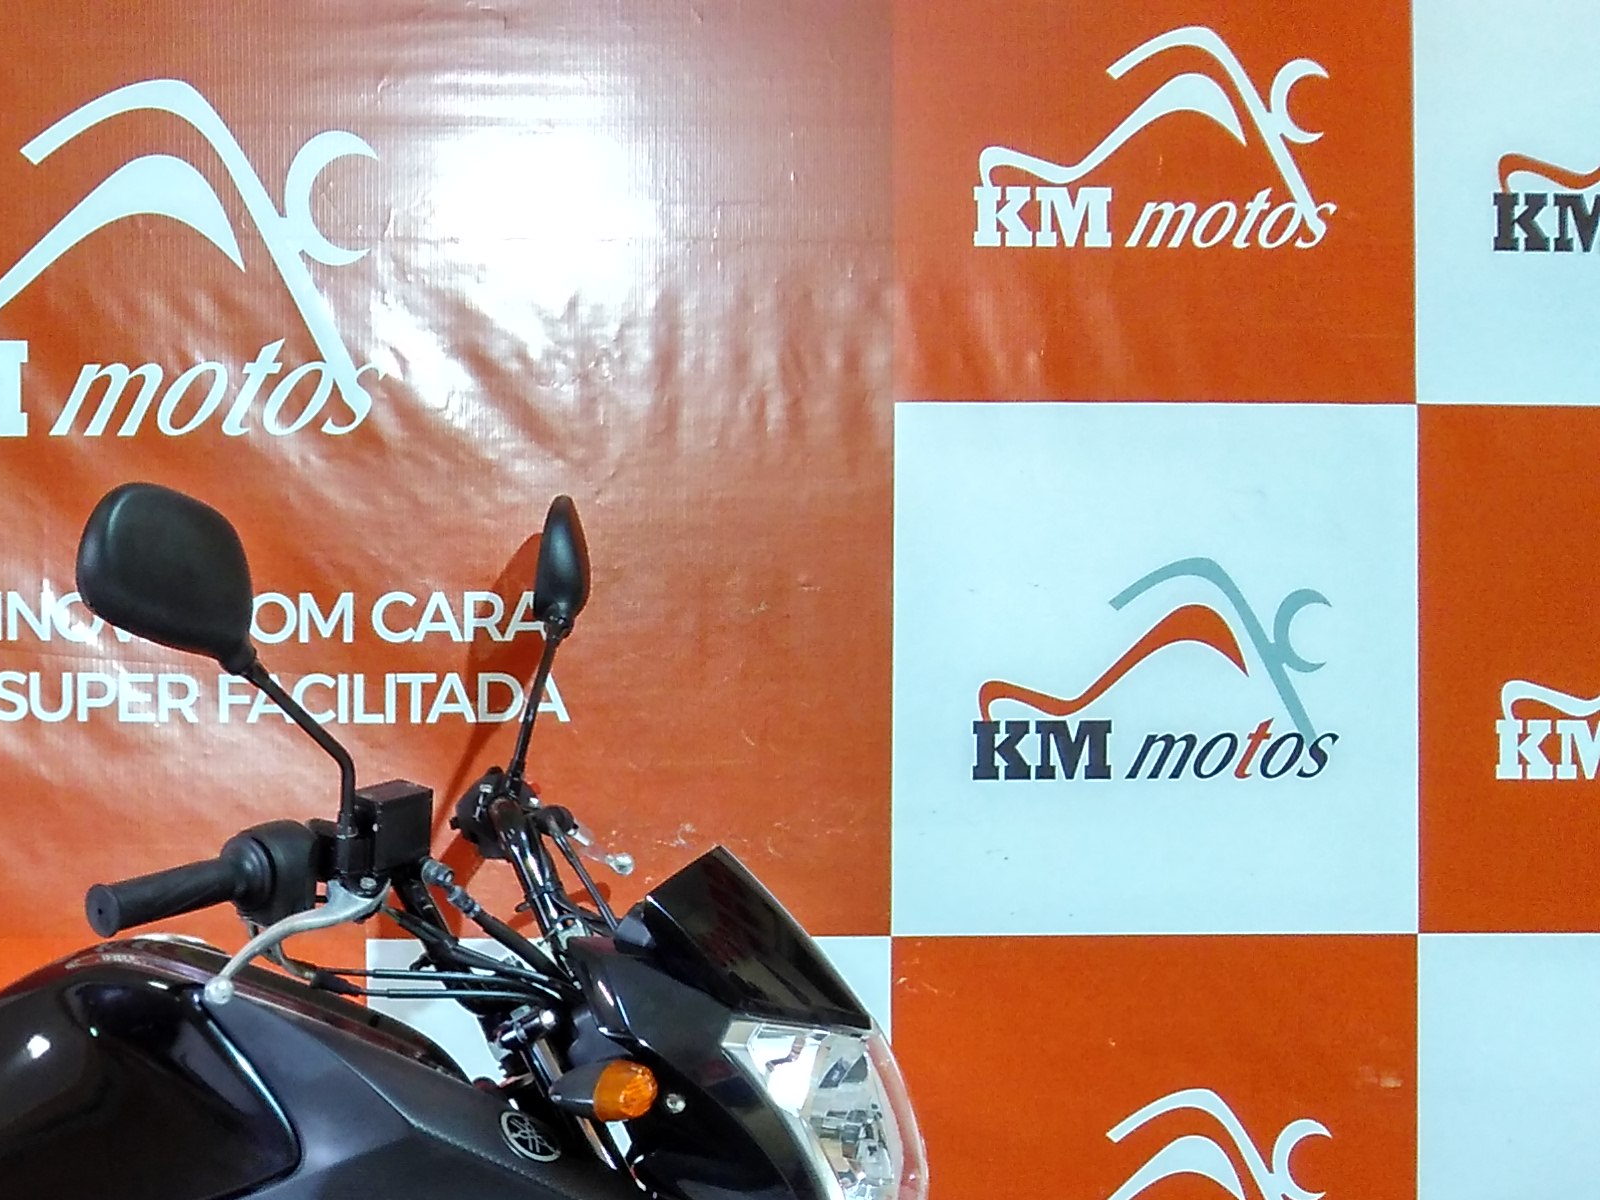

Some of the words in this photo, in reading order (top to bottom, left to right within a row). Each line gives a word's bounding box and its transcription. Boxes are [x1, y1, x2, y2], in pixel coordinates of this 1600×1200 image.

[973, 185, 1112, 249] KM
[1125, 187, 1337, 250] motos
[51, 339, 382, 437] motos
[248, 591, 354, 644] OM
[371, 590, 547, 643] CARA
[218, 673, 571, 724] FACILITADA
[973, 719, 1112, 781] KM
[1125, 718, 1339, 780] motos
